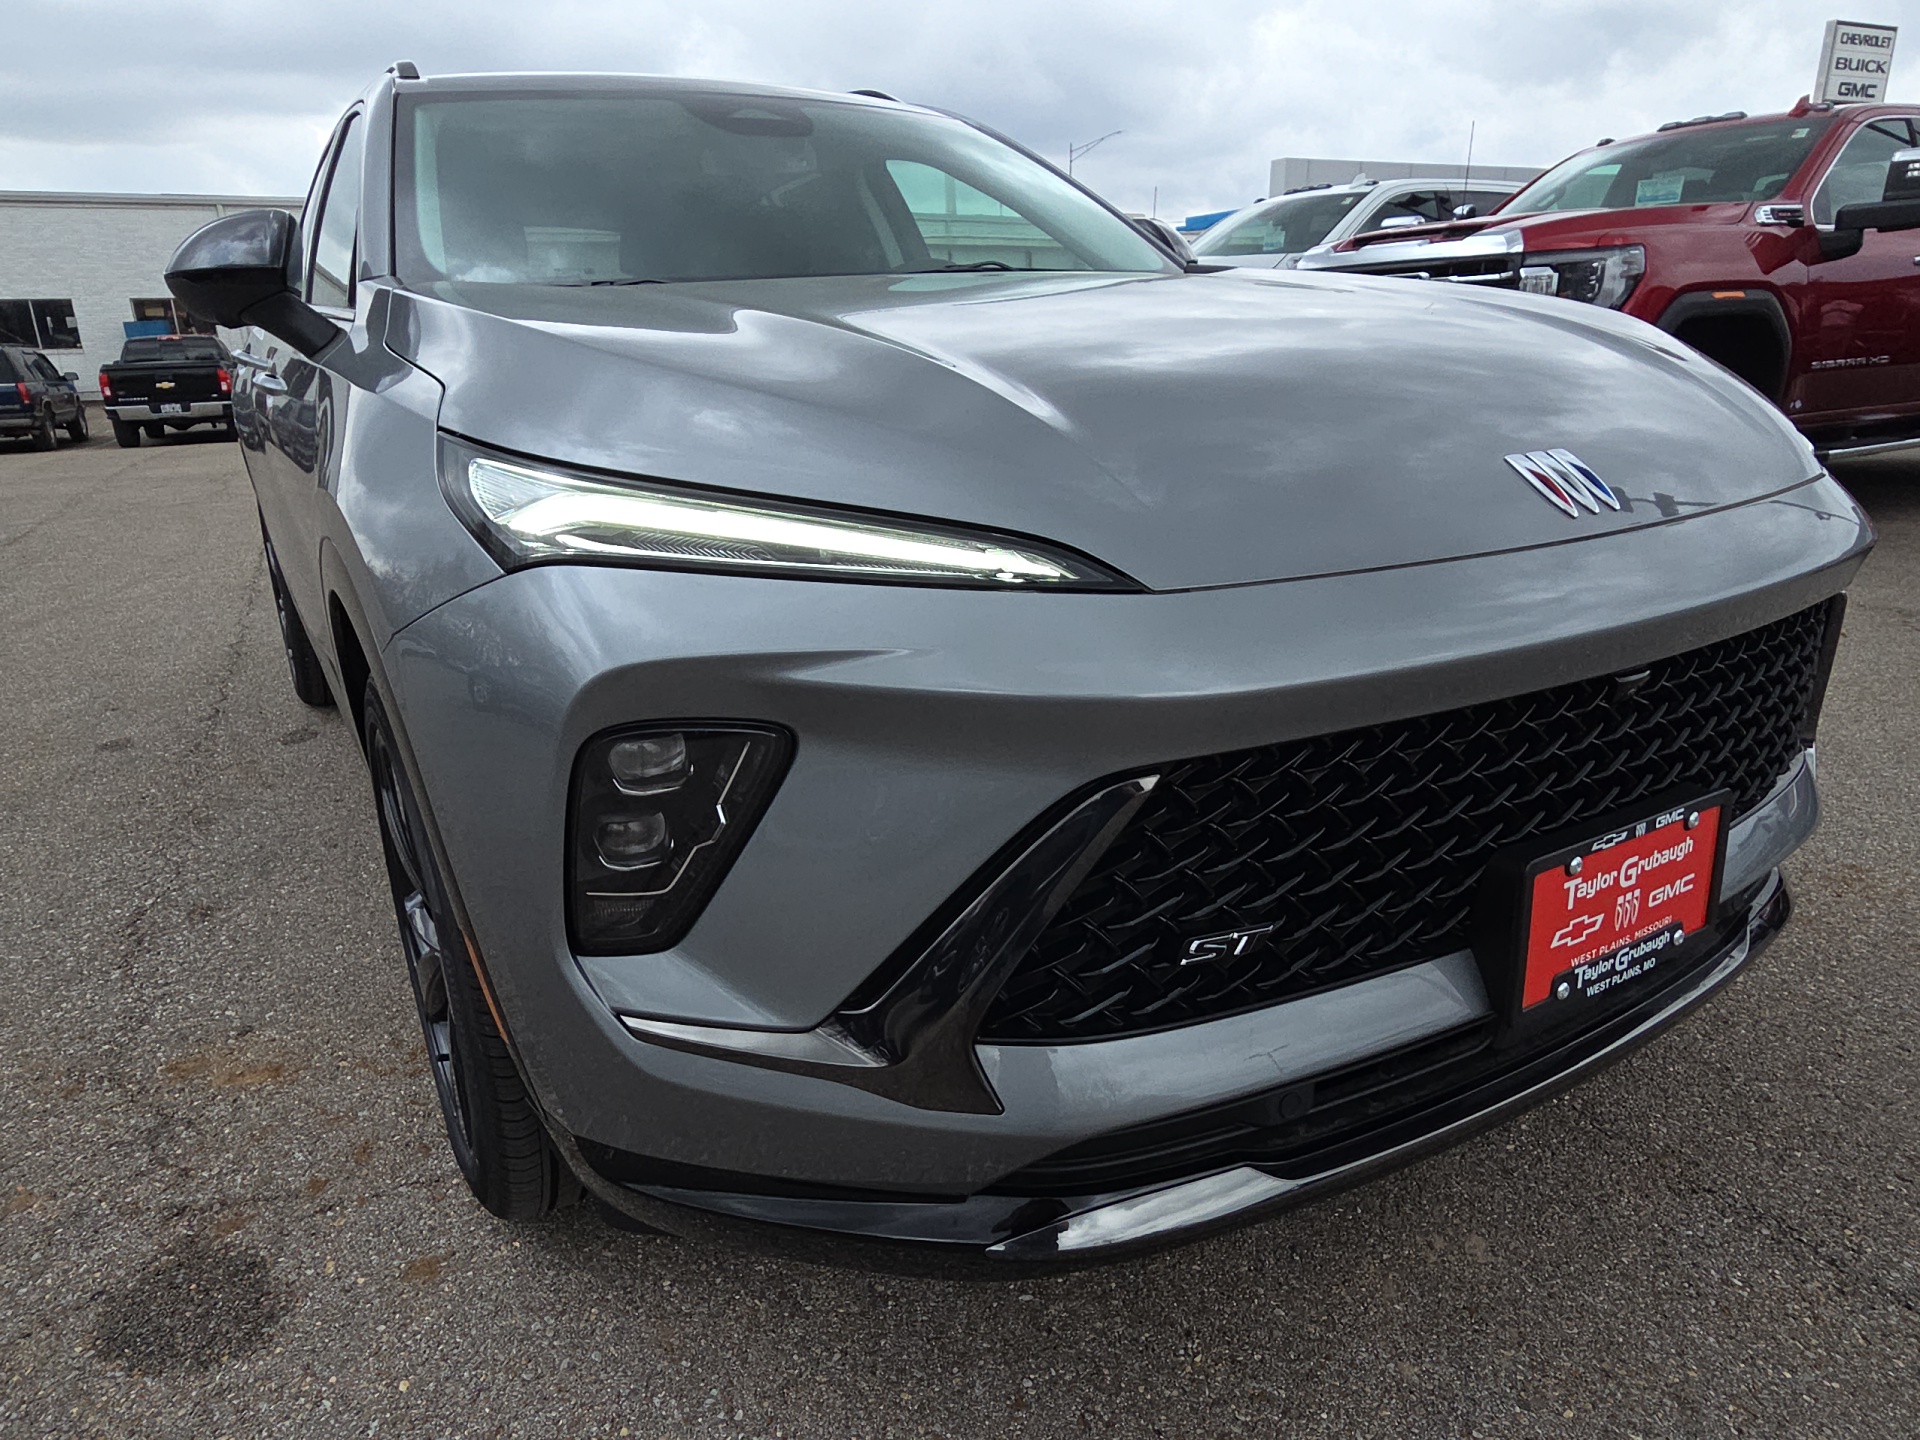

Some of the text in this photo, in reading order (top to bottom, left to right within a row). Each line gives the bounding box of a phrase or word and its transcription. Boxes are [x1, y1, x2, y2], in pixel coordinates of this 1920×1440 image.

[1840, 32, 1892, 49] CHEVROLET
[1834, 56, 1887, 74] BUICK
[1837, 81, 1878, 98] GMC
[1655, 808, 1685, 829] GMC
[1564, 836, 1694, 910] Taylor Grubaugh
[1648, 873, 1695, 908] GMC
[1180, 924, 1274, 966] ST
[1571, 949, 1597, 967] WEST
[1634, 915, 1672, 940] MISSOURI
[1574, 931, 1670, 989] Taylor Grubaugh
[1586, 957, 1656, 997] WEST PLAINS, MO
